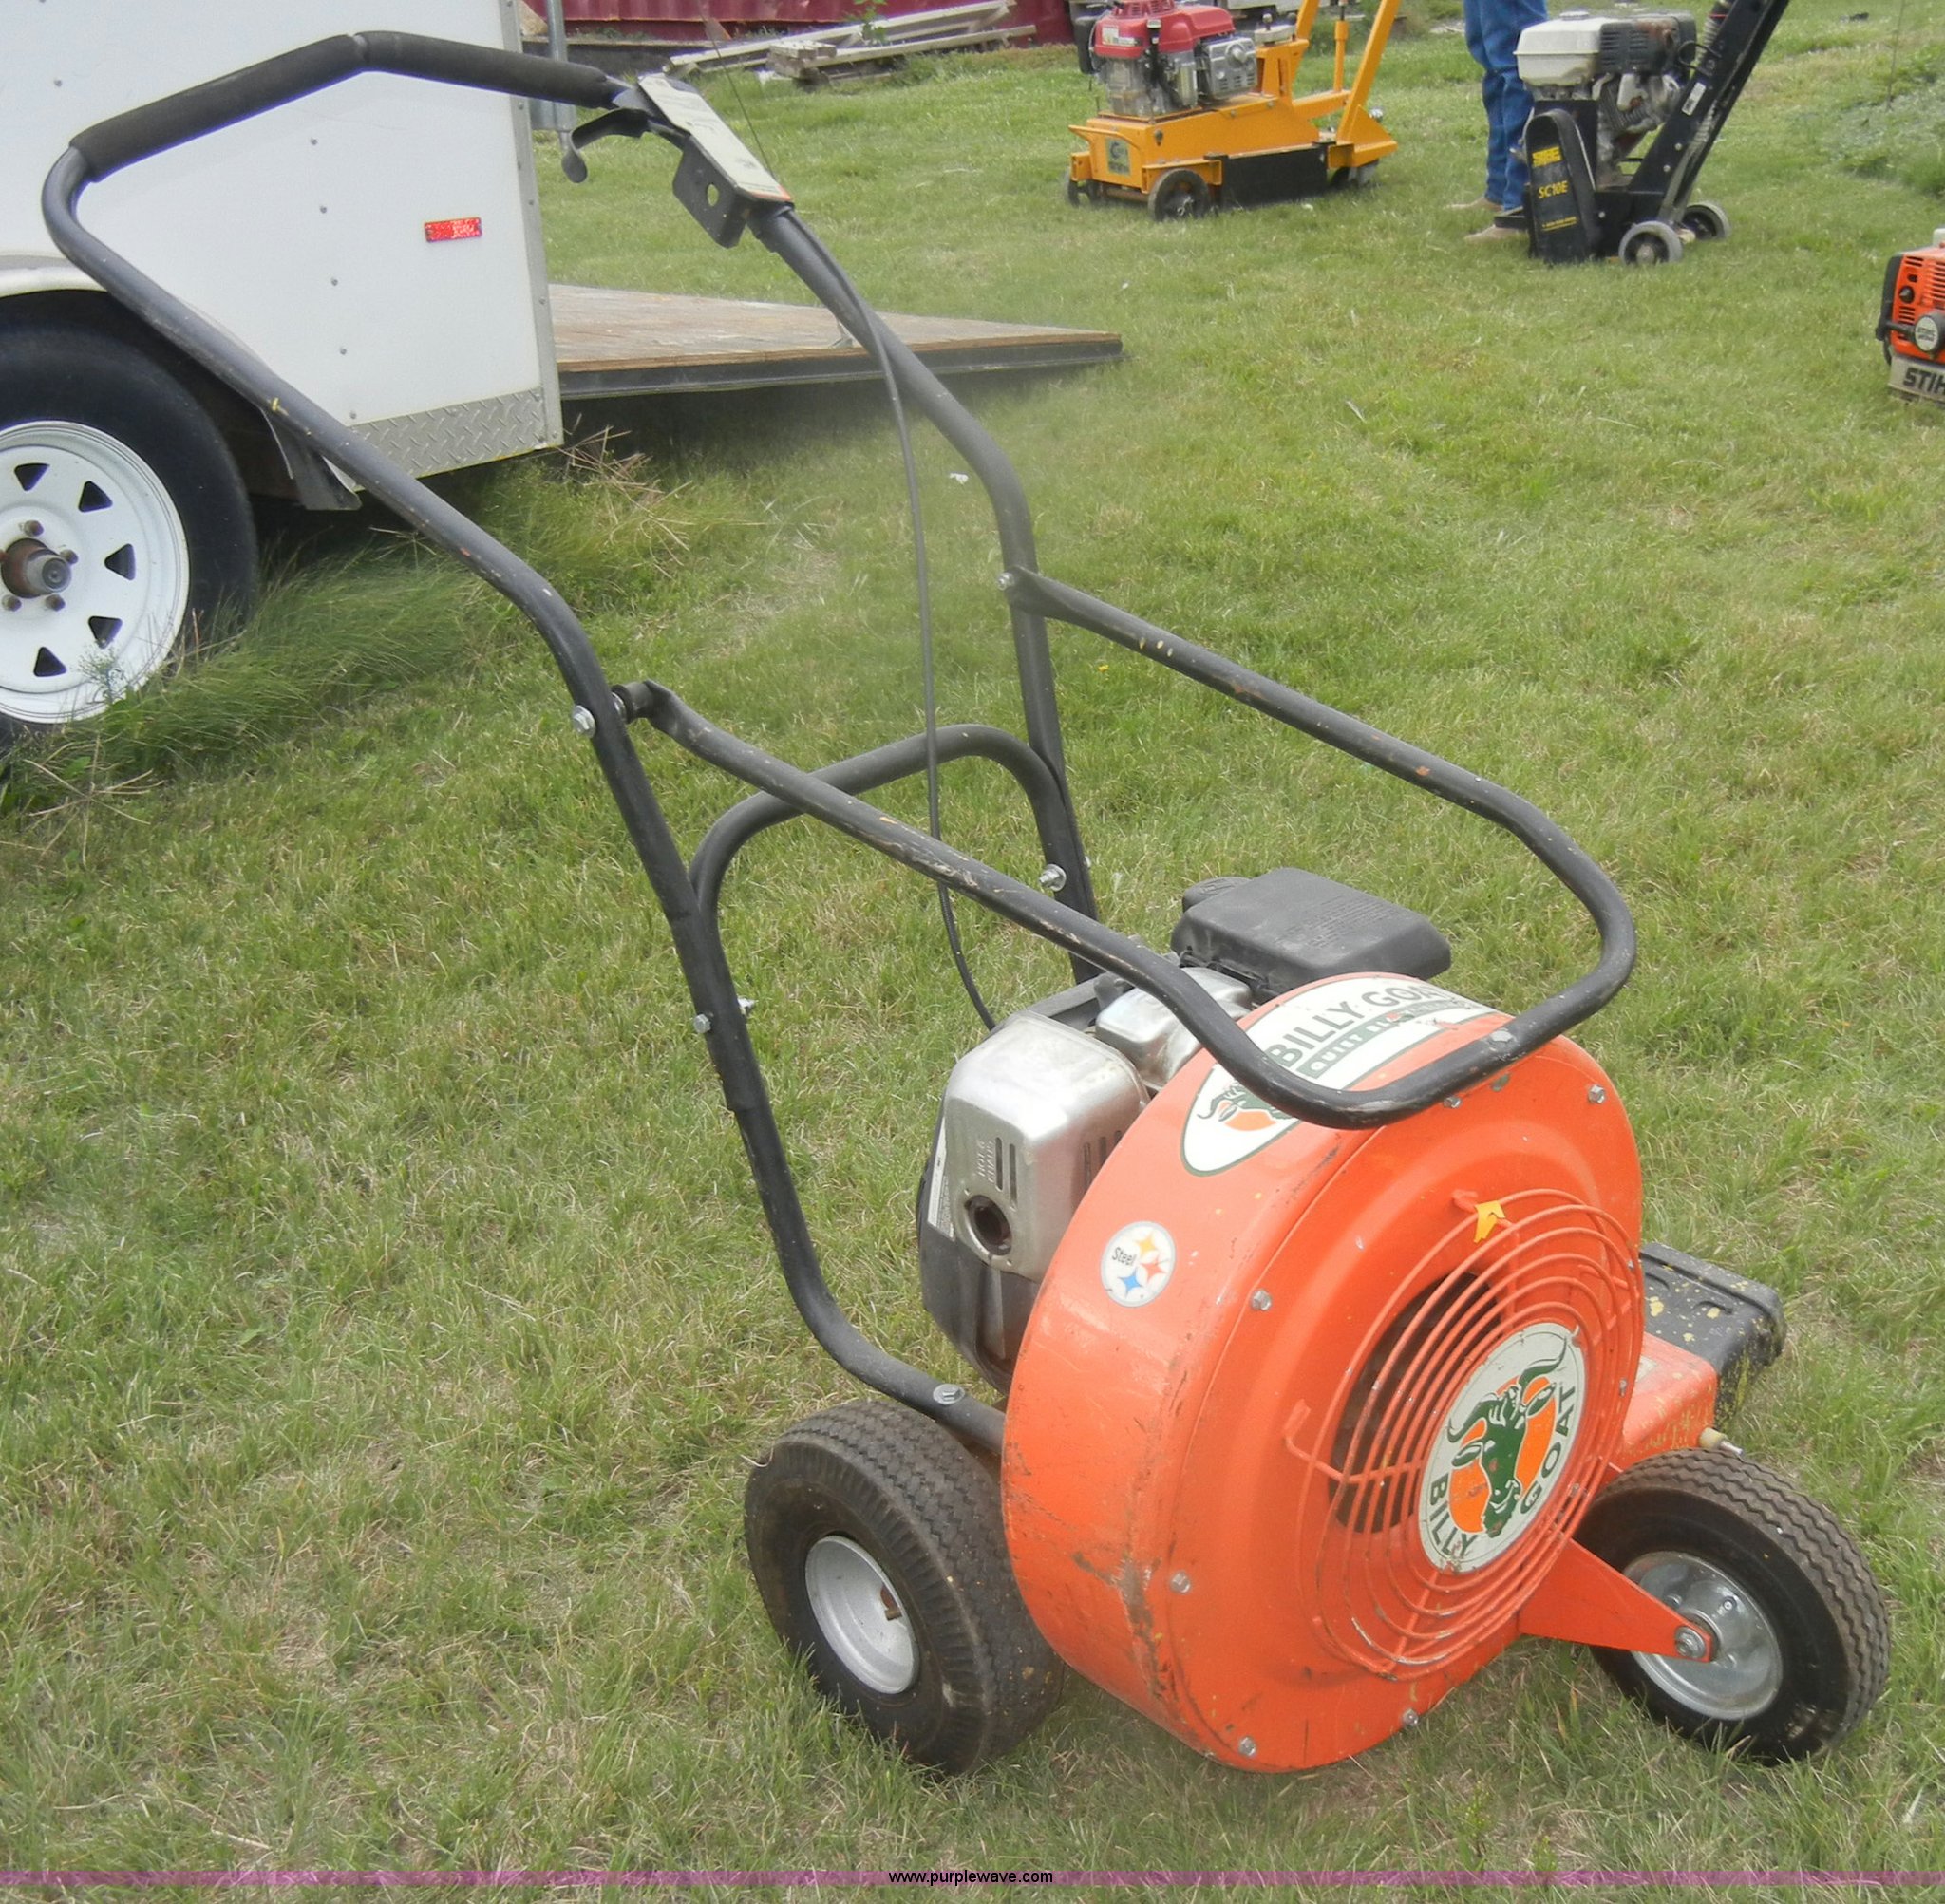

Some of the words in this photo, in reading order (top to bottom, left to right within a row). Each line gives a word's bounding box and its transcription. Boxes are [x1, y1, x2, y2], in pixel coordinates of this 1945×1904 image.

[1267, 1001, 1365, 1068] BILLY
[1112, 1247, 1136, 1266] Steel
[1430, 1474, 1478, 1556] BILLY
[1520, 1386, 1575, 1515] GOAT
